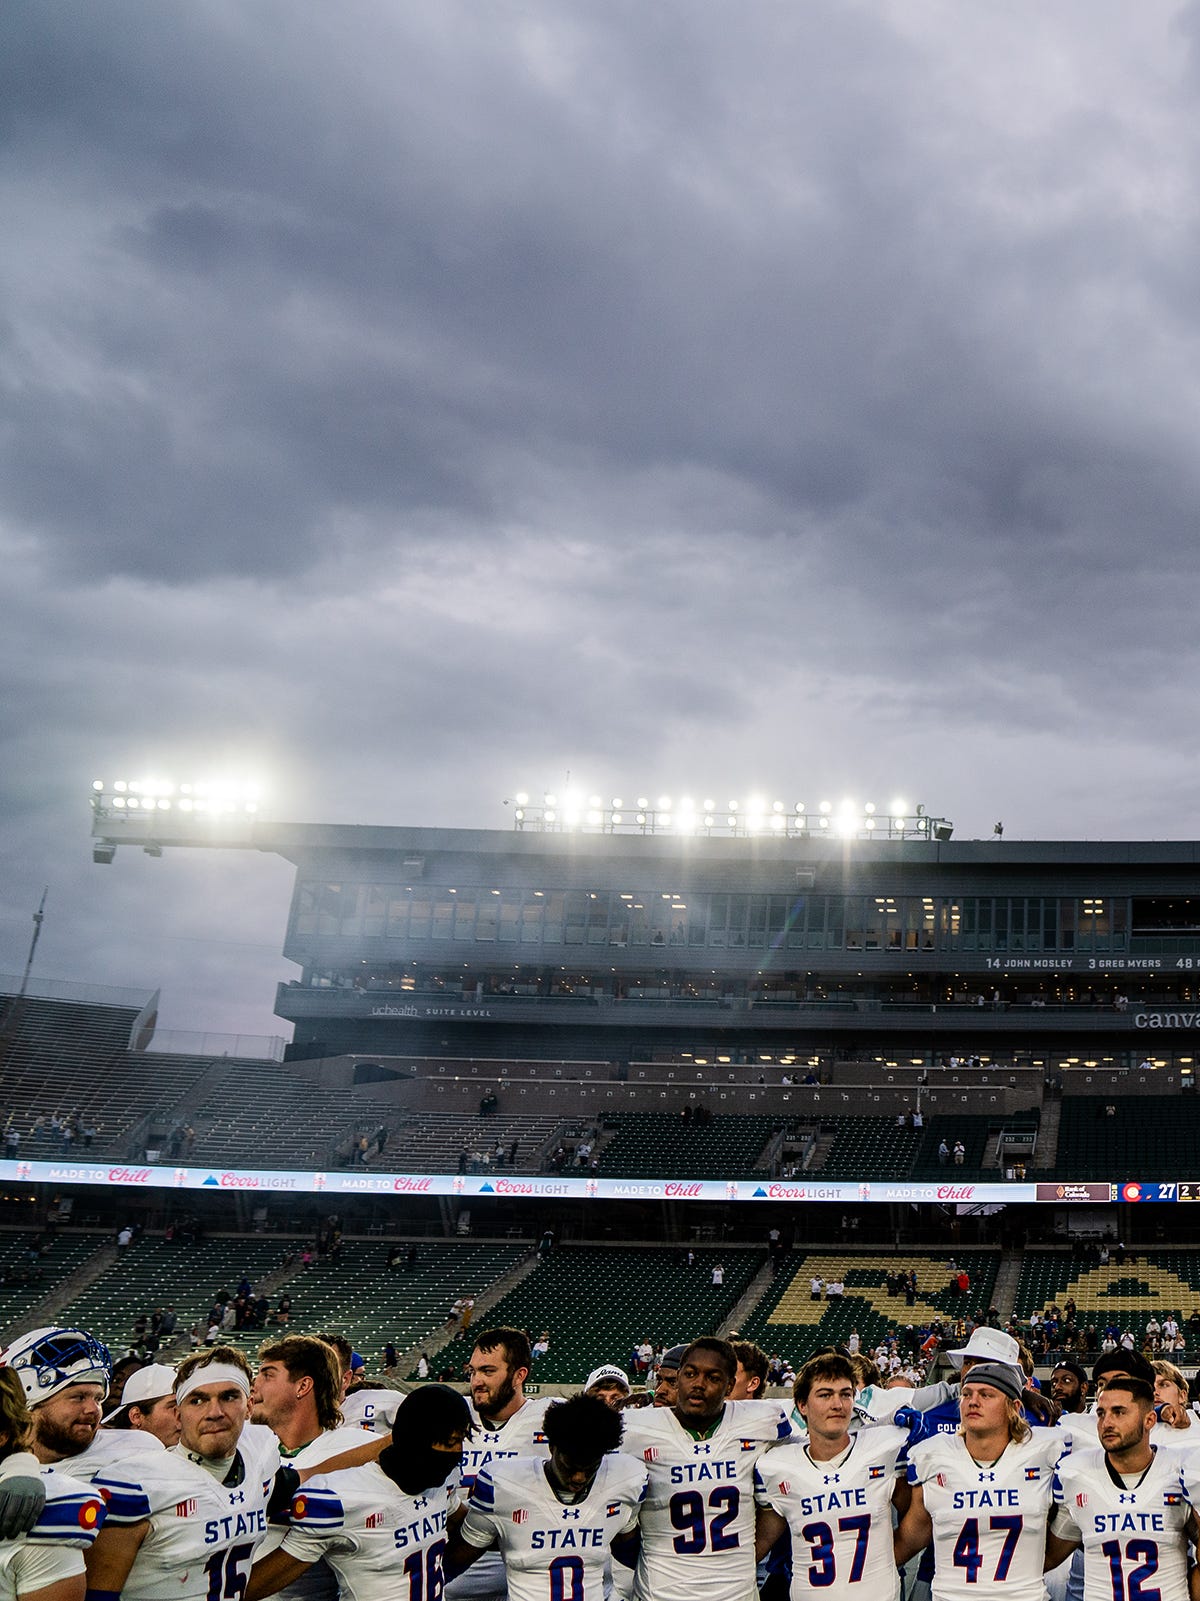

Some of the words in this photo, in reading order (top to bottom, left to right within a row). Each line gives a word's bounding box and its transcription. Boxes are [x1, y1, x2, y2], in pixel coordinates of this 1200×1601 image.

[986, 958, 1001, 969] 14
[1004, 959, 1030, 968] JOHN
[1034, 959, 1073, 968] MOSLEY
[1088, 958, 1096, 969] 3
[1099, 959, 1125, 968] GREG
[1128, 959, 1162, 968] MYERS
[1176, 958, 1193, 969] 48
[371, 1004, 418, 1016] uchealth
[426, 1008, 455, 1016] SUITE
[48, 1169, 86, 1179] MADE
[88, 1170, 104, 1180] TO
[108, 1167, 153, 1182] Chill
[220, 1172, 258, 1187] Coors
[260, 1178, 296, 1188] LIGHT
[342, 1179, 375, 1188] MADE
[376, 1180, 391, 1189] TO
[394, 1177, 433, 1191] Chill
[495, 1179, 533, 1193] Coors
[534, 1184, 569, 1194] LIGHT
[613, 1186, 646, 1194] MADE
[648, 1186, 662, 1195] TO
[664, 1183, 704, 1196] Chill
[768, 1184, 806, 1198] Coors
[808, 1189, 842, 1198] LIGHT
[1158, 1184, 1176, 1199] 27
[1181, 1185, 1190, 1196] 2
[886, 1189, 918, 1198] MADE
[920, 1189, 934, 1198] TO
[937, 1186, 975, 1199] Chill
[364, 1404, 375, 1418] C
[670, 1461, 737, 1484] STATE
[801, 1488, 867, 1516] STATE
[953, 1489, 1019, 1509] STATE
[204, 1509, 266, 1544] STATE
[669, 1485, 741, 1555] 92
[1094, 1513, 1164, 1533] STATE
[394, 1509, 448, 1549] STATE
[531, 1528, 603, 1549] STATE
[802, 1513, 871, 1587] 37
[953, 1514, 1023, 1583] 47
[203, 1541, 256, 1601] 15
[1101, 1538, 1161, 1601] 12
[549, 1555, 584, 1601] 0
